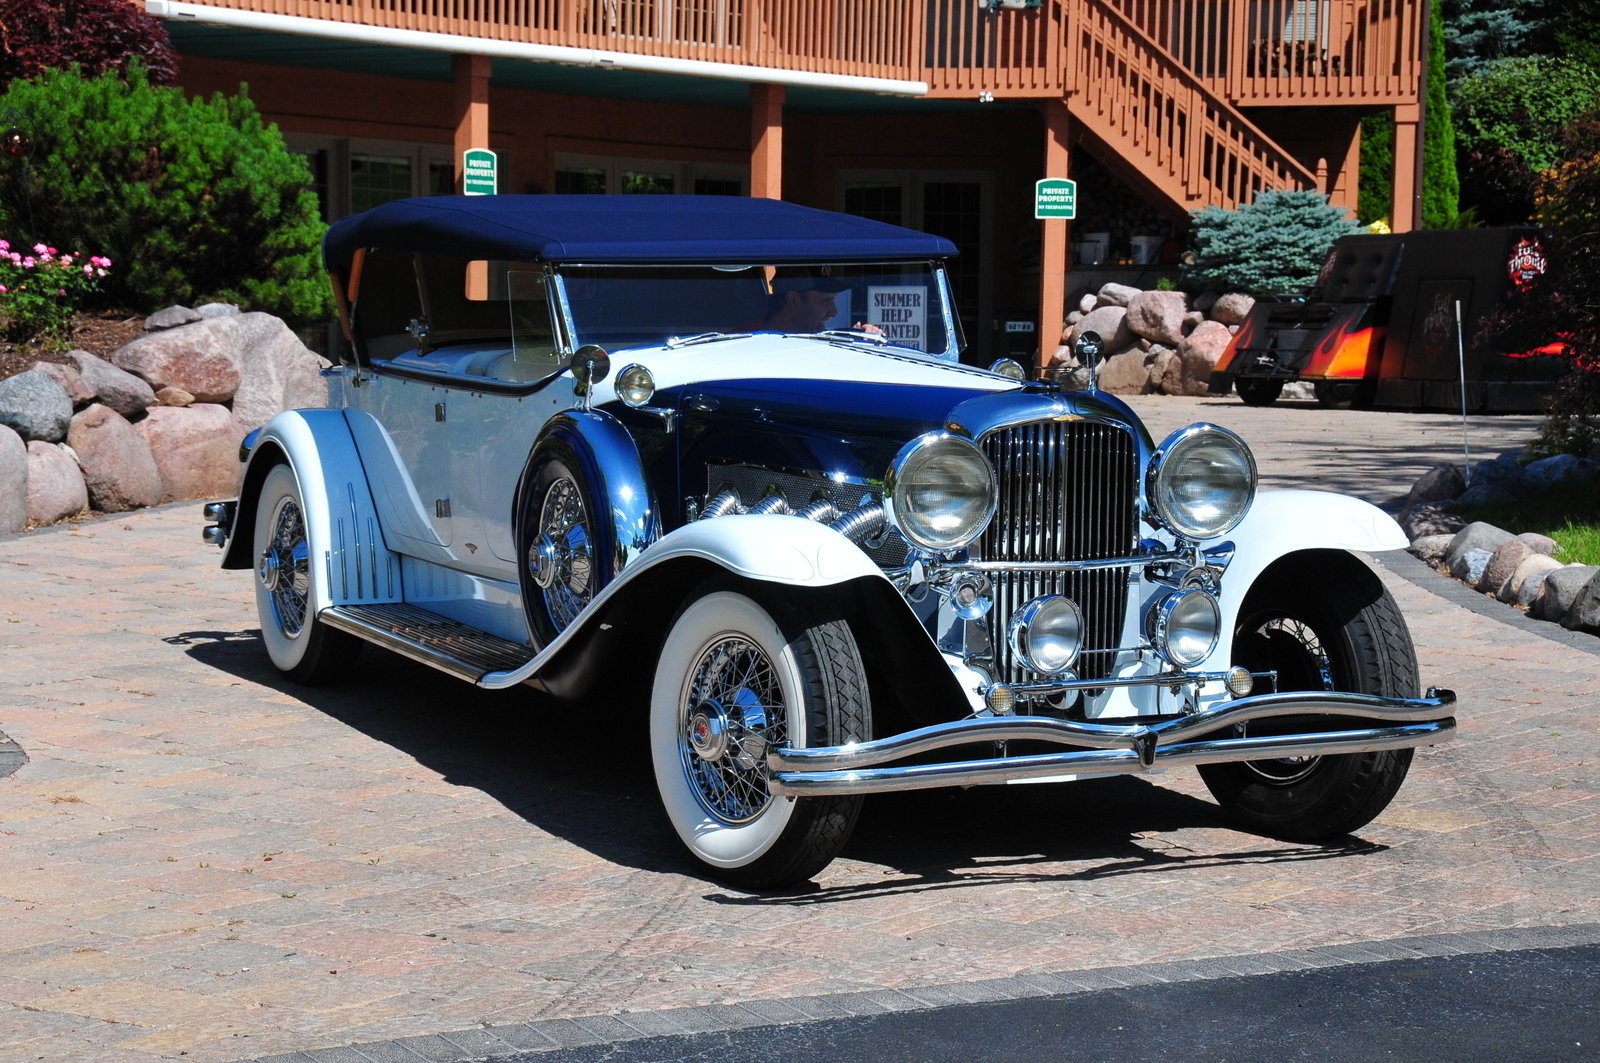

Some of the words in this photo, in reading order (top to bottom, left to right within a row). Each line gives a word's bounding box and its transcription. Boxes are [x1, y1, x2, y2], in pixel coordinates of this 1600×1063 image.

[1042, 187, 1070, 195] PRIVATE
[1038, 195, 1073, 203] PROPERTY
[874, 293, 921, 307] SUMMER
[881, 309, 912, 322] HELP
